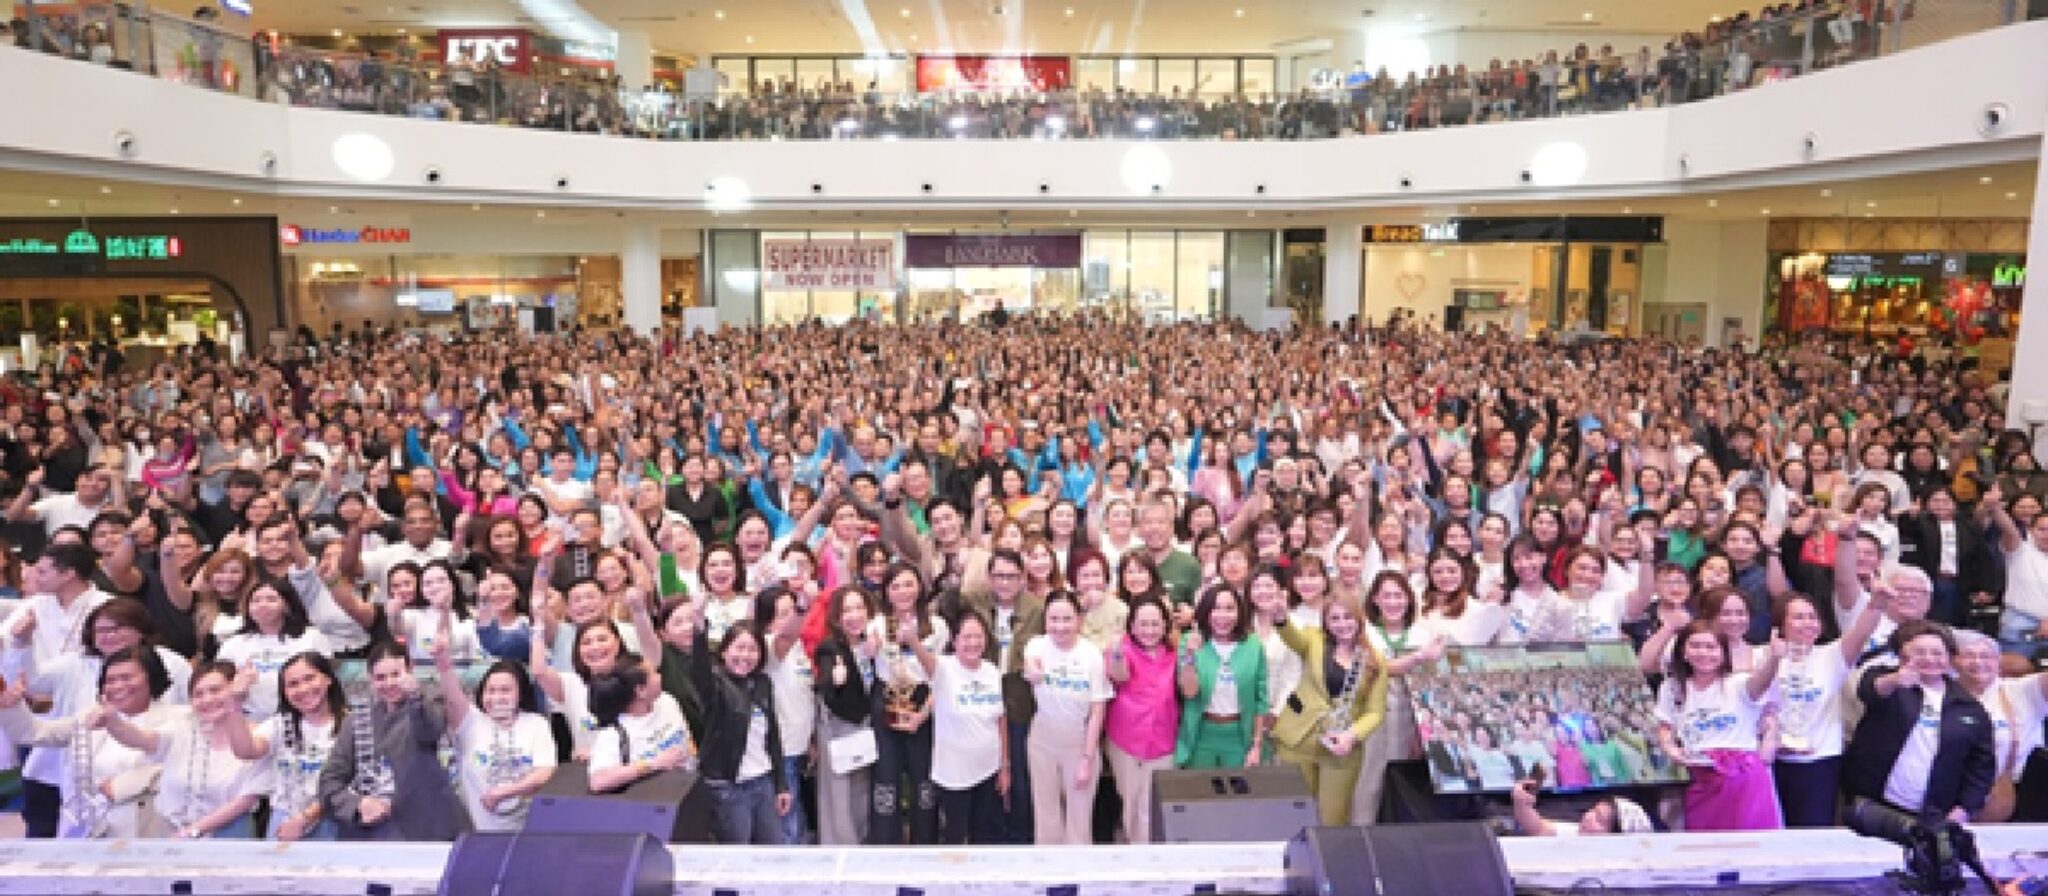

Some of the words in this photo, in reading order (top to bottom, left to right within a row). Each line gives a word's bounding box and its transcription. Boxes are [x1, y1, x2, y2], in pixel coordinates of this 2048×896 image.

[770, 247, 888, 272] SUPERMARKET
[785, 274, 825, 286] NOW
[832, 274, 876, 286] OPEN
